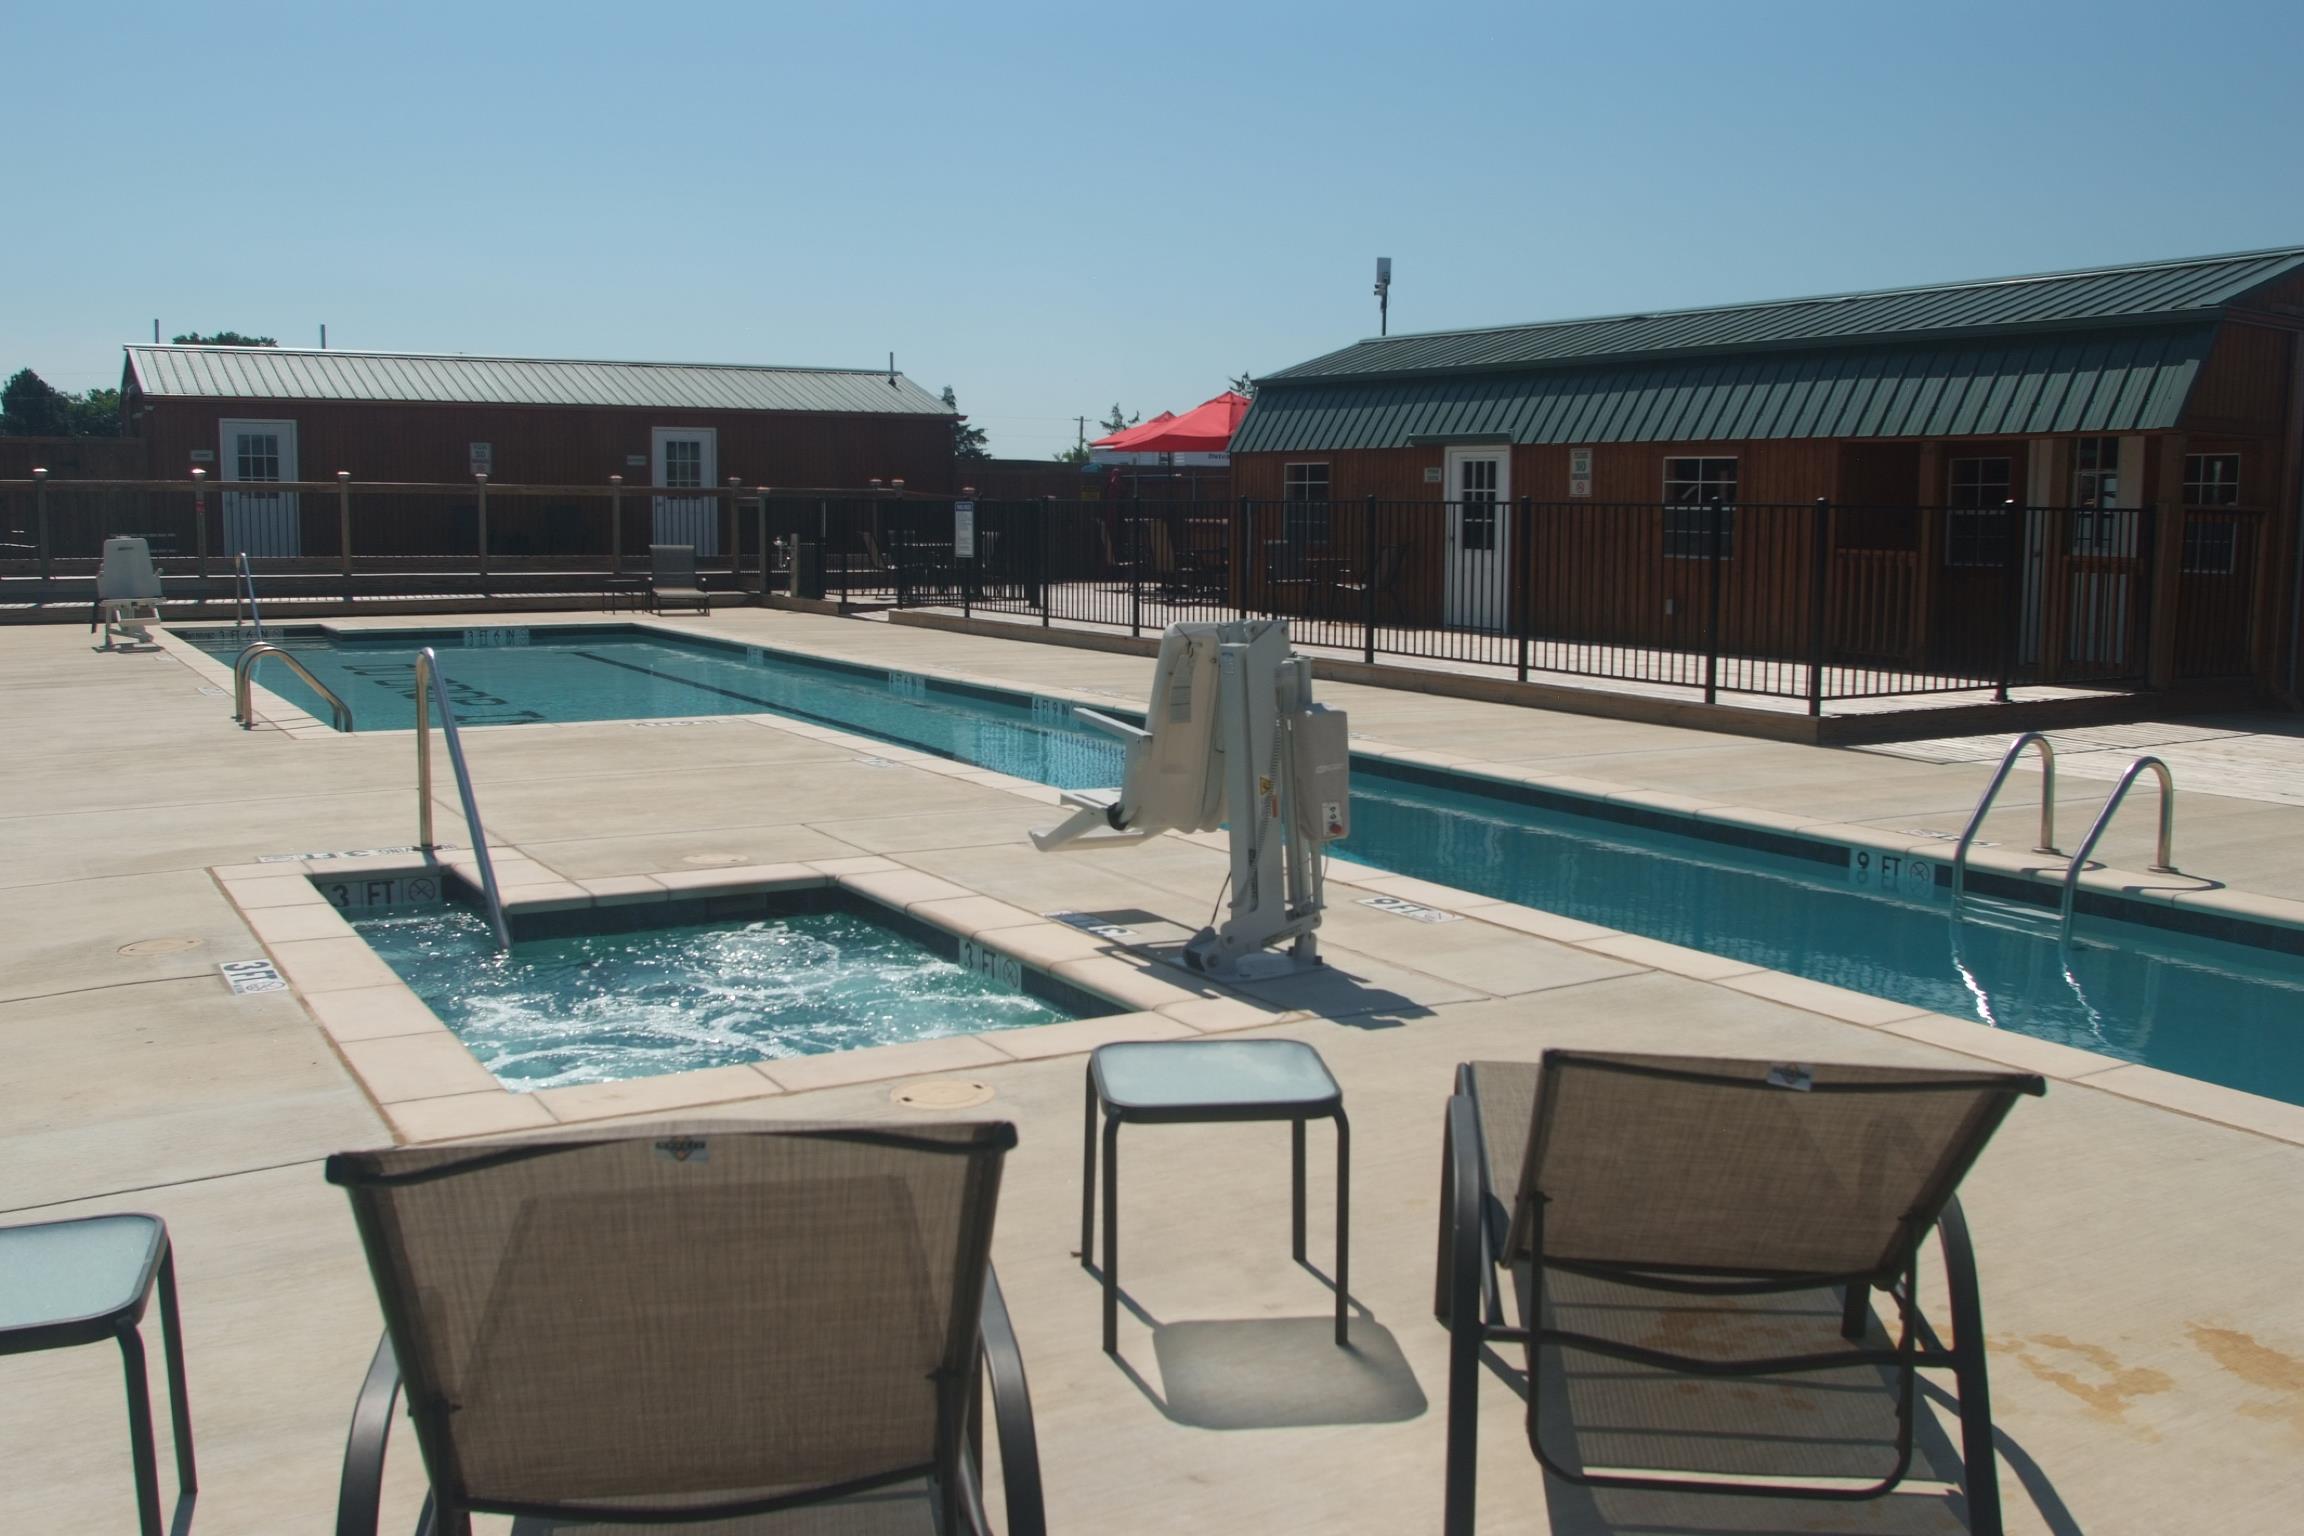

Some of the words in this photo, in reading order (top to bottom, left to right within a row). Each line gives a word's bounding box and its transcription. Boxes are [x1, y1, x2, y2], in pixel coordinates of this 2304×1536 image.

[304, 852, 337, 860] FT
[343, 850, 369, 858] 3
[1857, 852, 1869, 869] 9
[1881, 855, 1902, 876] FT
[331, 884, 350, 908] 3
[366, 881, 395, 906] FT
[1365, 897, 1401, 905] 9
[1387, 904, 1432, 914] FT
[223, 961, 271, 971] 3
[964, 942, 974, 969] 3
[982, 949, 997, 979] FT
[230, 970, 278, 982] FT
